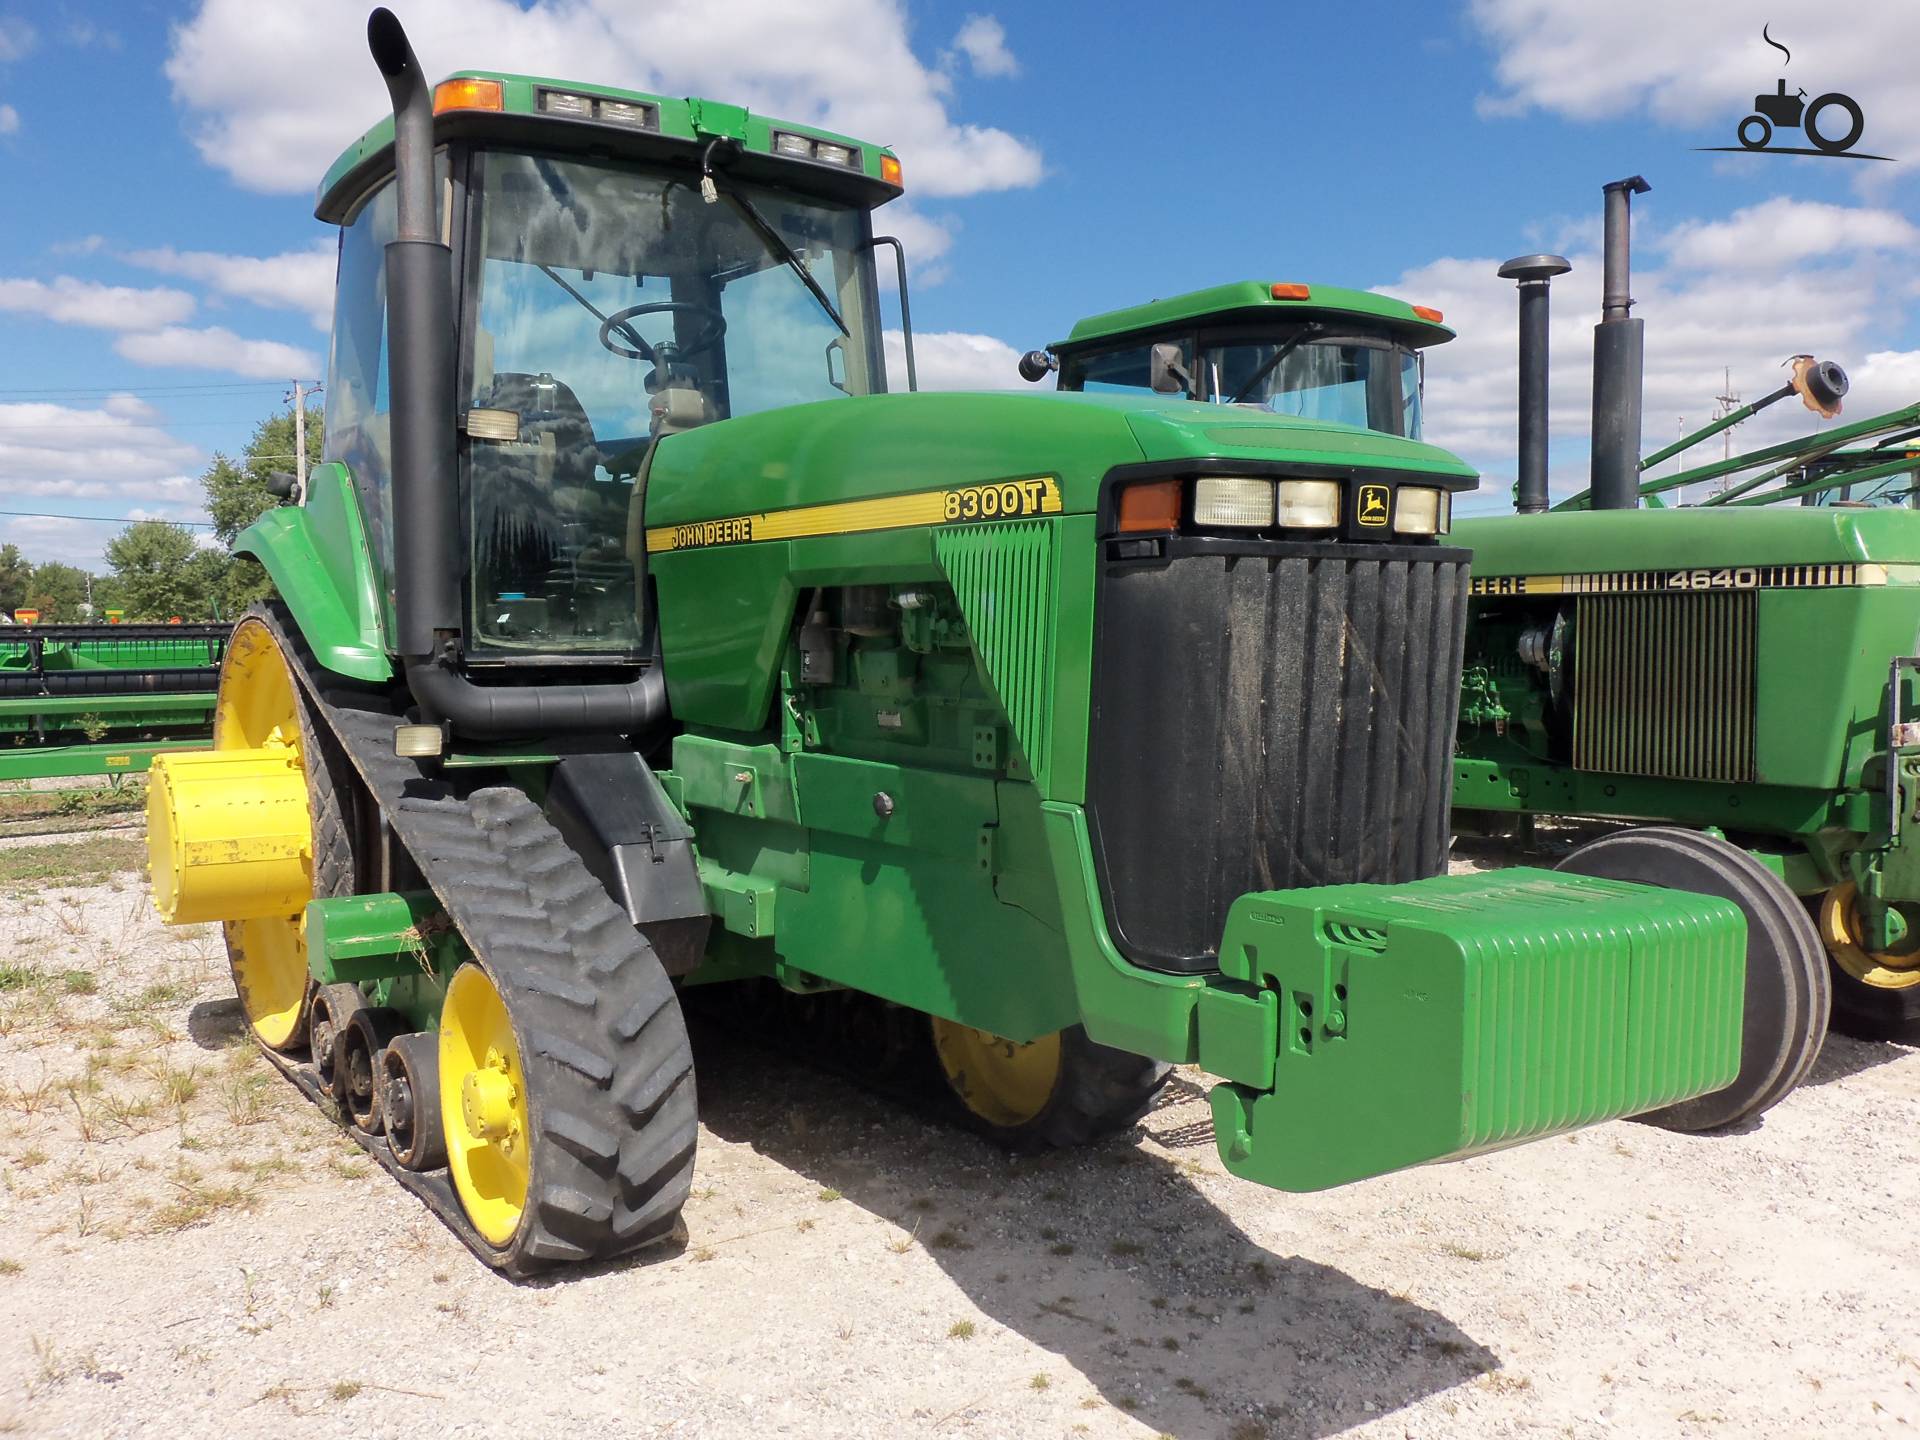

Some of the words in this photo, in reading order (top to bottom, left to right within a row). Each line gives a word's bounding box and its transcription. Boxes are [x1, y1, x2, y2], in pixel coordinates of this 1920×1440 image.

[672, 525, 703, 548] JOHN
[707, 518, 751, 544] DEERE
[1471, 576, 1526, 595] EERE
[1669, 567, 1757, 589] 4640
